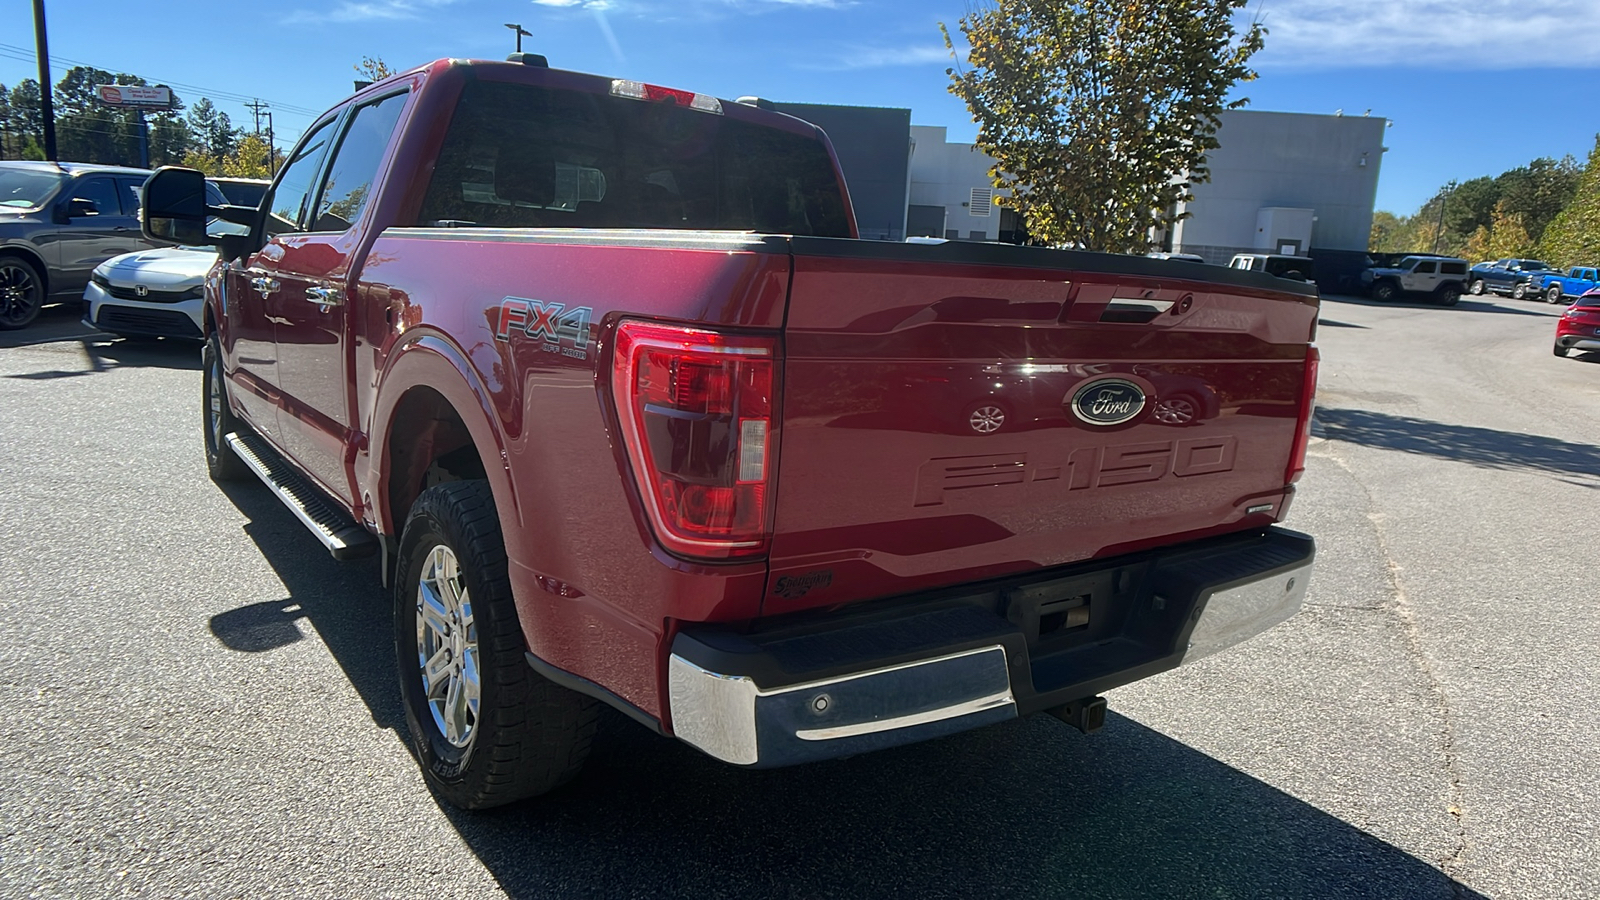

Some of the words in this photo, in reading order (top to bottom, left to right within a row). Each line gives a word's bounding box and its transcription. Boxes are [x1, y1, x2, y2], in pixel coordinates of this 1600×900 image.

[496, 296, 592, 349] FX4
[542, 342, 560, 353] OFF
[562, 346, 587, 360] ROAD
[1091, 389, 1133, 415] Ford
[913, 435, 1238, 508] F-150
